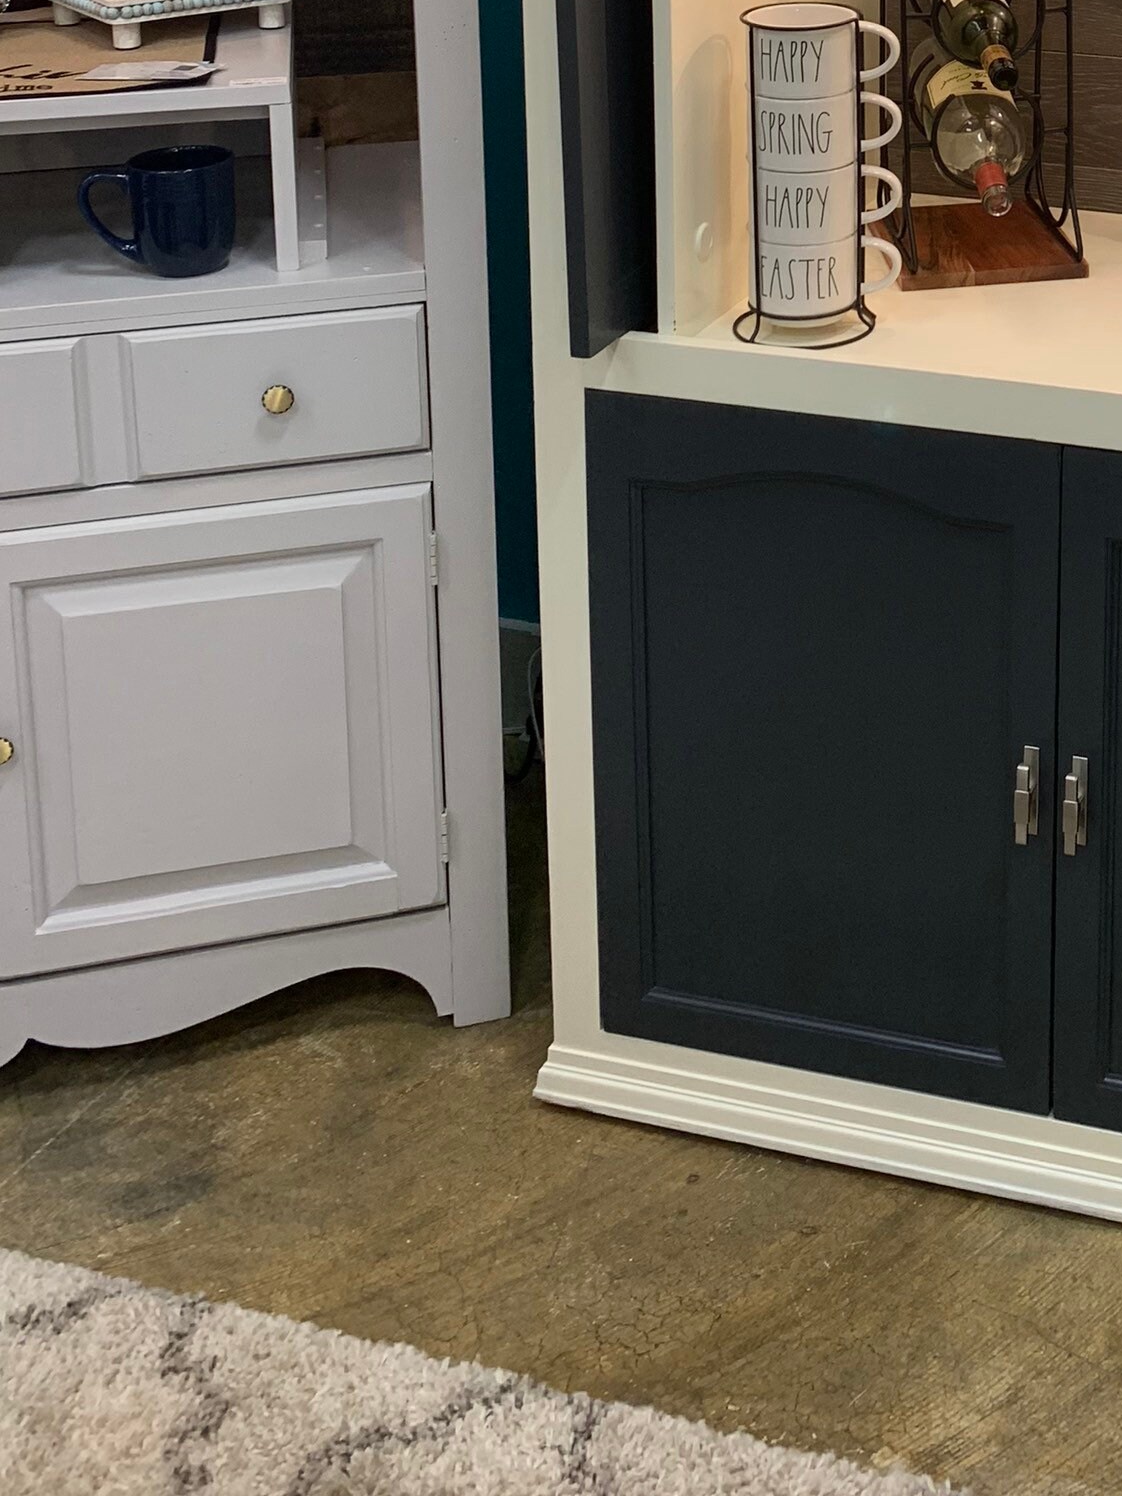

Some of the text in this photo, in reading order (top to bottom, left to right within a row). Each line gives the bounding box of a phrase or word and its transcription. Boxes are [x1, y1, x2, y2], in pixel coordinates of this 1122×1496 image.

[760, 38, 825, 84] HAPPY
[758, 110, 834, 156] SPRING
[764, 185, 830, 229] HAPPY
[759, 254, 840, 301] EASTER
